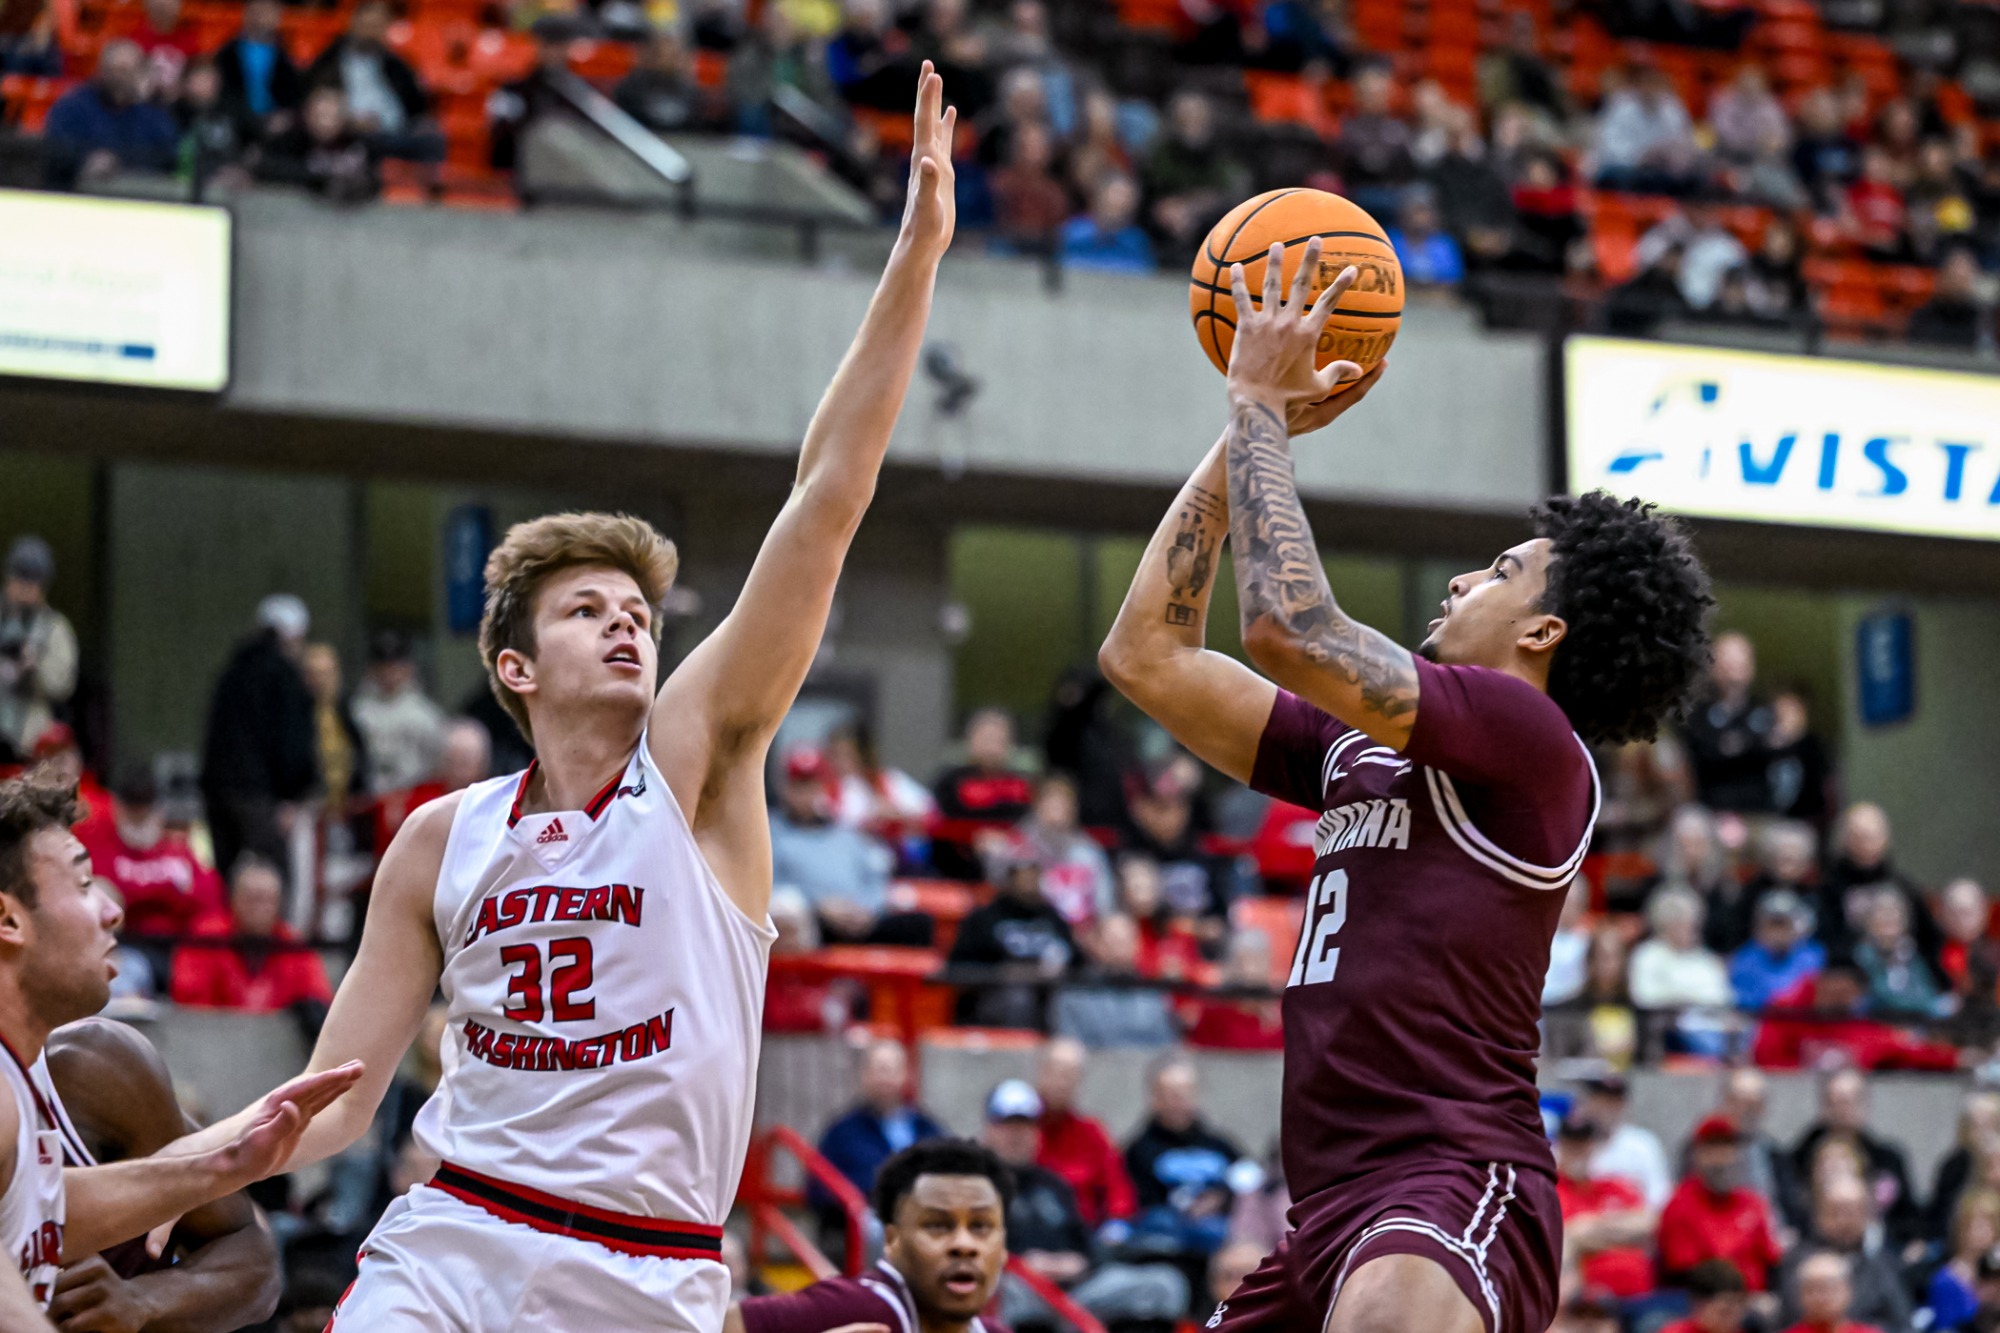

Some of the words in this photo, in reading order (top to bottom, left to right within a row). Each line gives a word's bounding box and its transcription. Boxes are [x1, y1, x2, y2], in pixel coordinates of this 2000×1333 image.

[536, 833, 569, 844] adidas
[1286, 867, 1349, 988] 12
[500, 936, 596, 1023] 32
[462, 1007, 675, 1071] WASHINGTON
